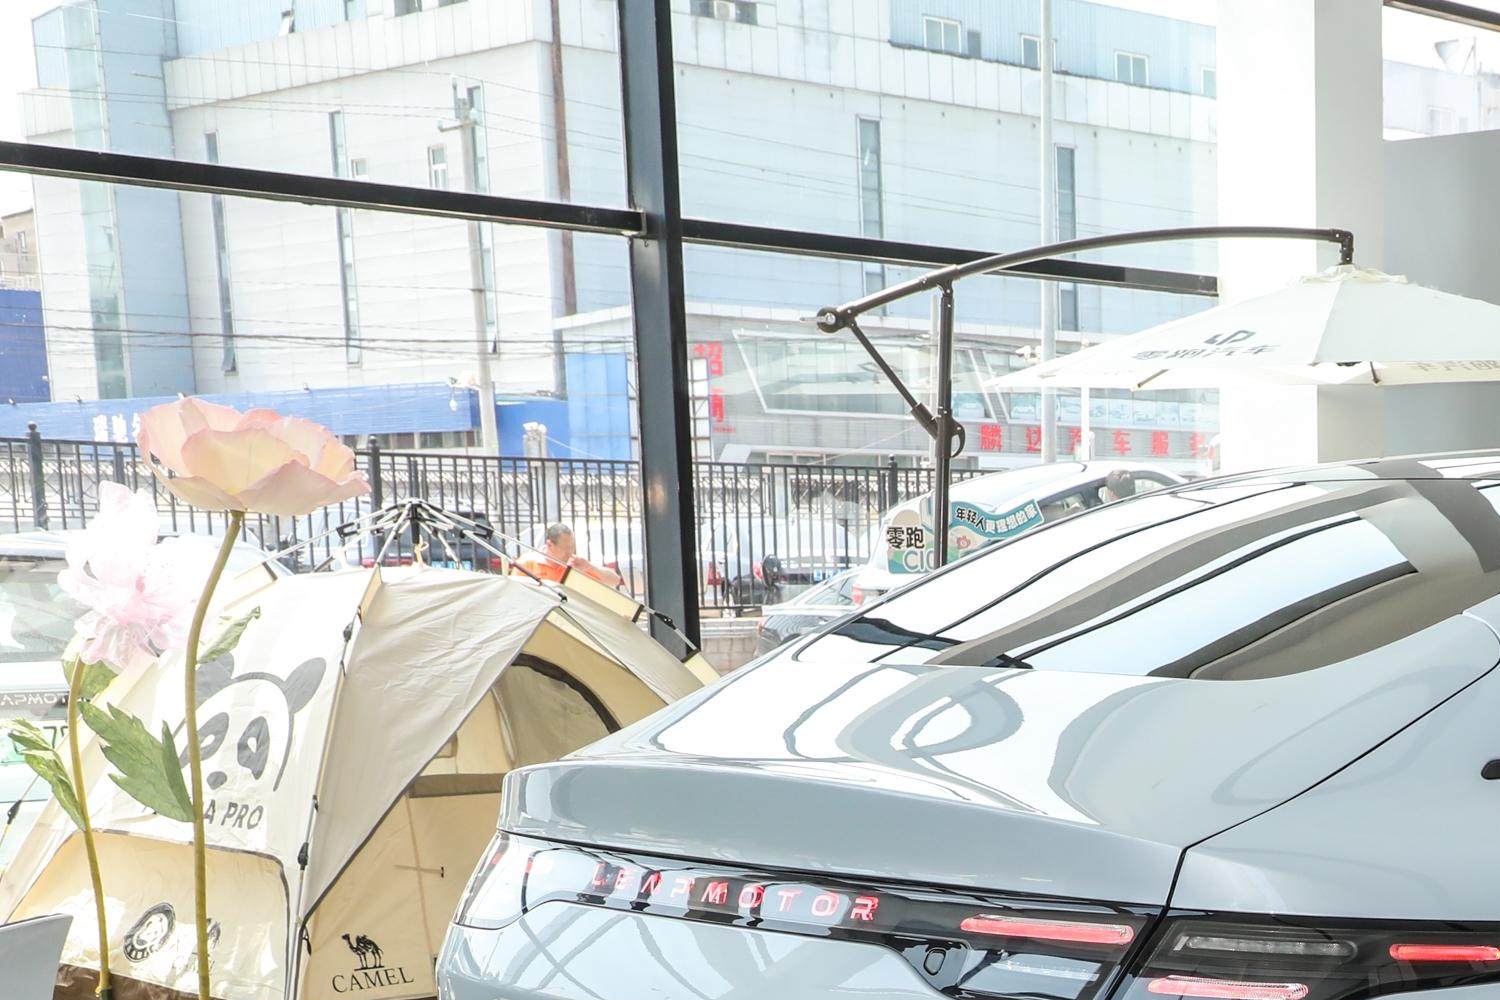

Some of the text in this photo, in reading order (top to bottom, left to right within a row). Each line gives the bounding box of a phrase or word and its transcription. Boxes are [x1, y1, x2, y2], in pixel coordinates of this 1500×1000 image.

[886, 526, 925, 549] 零跑
[220, 801, 264, 830] PRO
[592, 861, 880, 921] LEAPMOTOR
[331, 967, 415, 993] CAMEL
